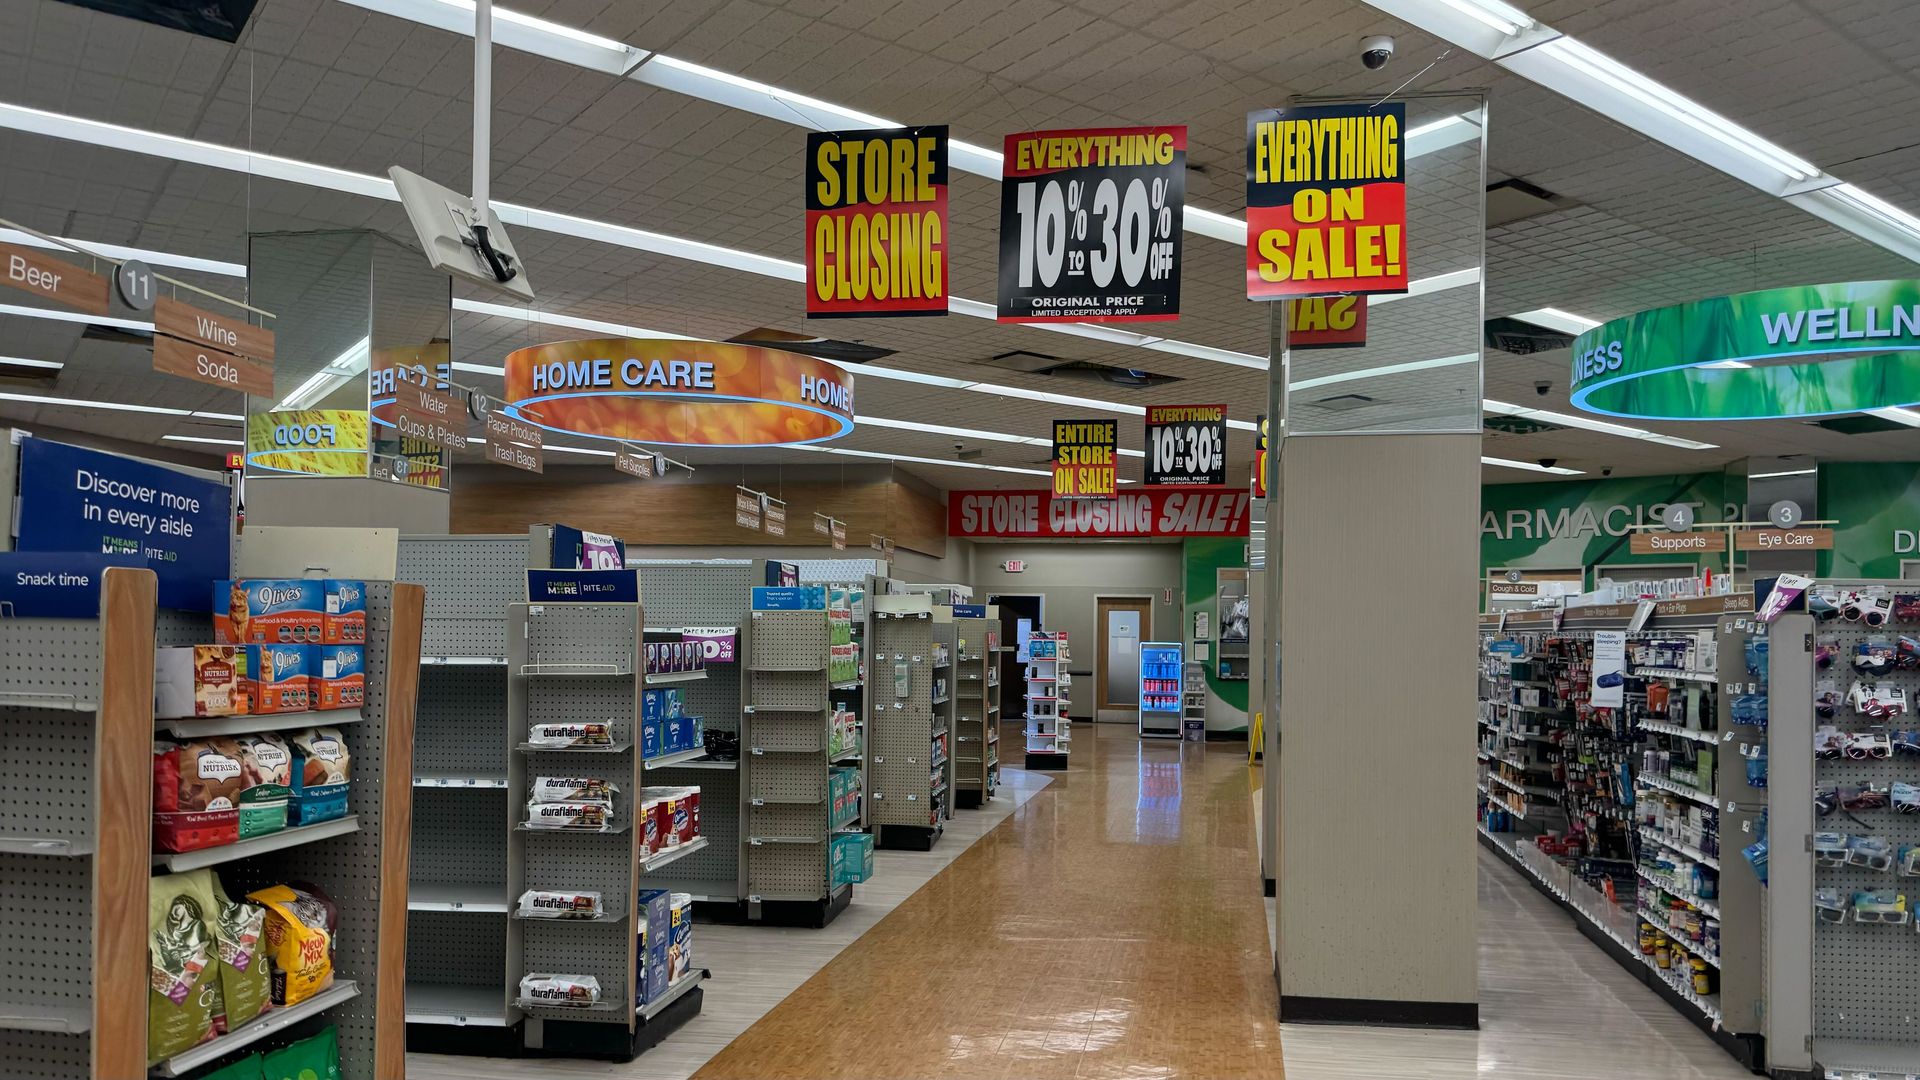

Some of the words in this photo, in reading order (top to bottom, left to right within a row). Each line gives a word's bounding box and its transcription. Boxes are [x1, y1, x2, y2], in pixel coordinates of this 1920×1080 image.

[1016, 133, 1174, 171] EVERYTHING
[1255, 114, 1399, 184] EVERYTHING
[817, 137, 936, 207] STORE
[1293, 188, 1366, 225] ON
[815, 209, 942, 302] CLOSING
[1068, 250, 1085, 271] TO
[1150, 242, 1174, 281] OFF
[1259, 224, 1402, 283] SALE!
[8, 254, 62, 293] Beer
[127, 271, 151, 300] 11
[1031, 296, 1100, 308] ORIGINAL
[1106, 295, 1144, 307] PRICE
[1031, 309, 1061, 317] LIMITED
[1063, 308, 1112, 317] EXCEPTIONS
[1115, 308, 1138, 316] APPLY
[196, 316, 238, 347] Wine
[1760, 303, 1920, 345] WELLN
[196, 354, 239, 385] Soda
[532, 358, 611, 391] HOME
[620, 357, 716, 390] CARE
[419, 391, 448, 415] Water
[474, 394, 487, 413] 12
[800, 373, 850, 413] HOME
[1151, 407, 1222, 423] EVERYTHING
[399, 415, 425, 440] Cups
[427, 426, 435, 440] &
[438, 427, 466, 448] Plates
[487, 413, 509, 436] Paper
[511, 421, 542, 444] Products
[1056, 423, 1114, 444] ENTIRE
[493, 443, 514, 463] Trash
[516, 453, 537, 473] Bags
[619, 455, 628, 470] Pet
[629, 459, 650, 477] Supplies
[1059, 445, 1113, 465] STORE
[1212, 453, 1222, 470] OFF
[76, 469, 157, 504] Discover
[161, 490, 200, 514] more
[1055, 467, 1074, 495] ON
[1078, 467, 1114, 494] SALE!
[83, 500, 102, 521] in
[107, 510, 157, 536] every
[160, 512, 194, 538] aisle
[961, 494, 1039, 533] STORE
[1050, 497, 1152, 534] CLOSING
[1158, 491, 1248, 533] SALE!
[1673, 510, 1685, 526] 4
[1780, 507, 1792, 522] 3
[102, 535, 110, 544] IT
[111, 537, 138, 549] MEANS
[1651, 535, 1706, 549] Supports
[1758, 532, 1783, 548] Eye
[1784, 532, 1814, 546] Care
[1008, 560, 1022, 572] EXIT
[1510, 572, 1518, 582] 3
[17, 572, 56, 587] Snack
[58, 572, 89, 587] time
[1492, 584, 1513, 593] Cough
[1521, 584, 1536, 593] Cold
[258, 586, 302, 614] 9Lives
[1596, 639, 1622, 647] sleeping?
[720, 651, 732, 659] OFF
[543, 727, 585, 737] duraflame
[545, 778, 587, 788] duraflame
[541, 806, 583, 816] duraflame
[533, 897, 574, 909] duraflame
[530, 987, 570, 999] duraflame
